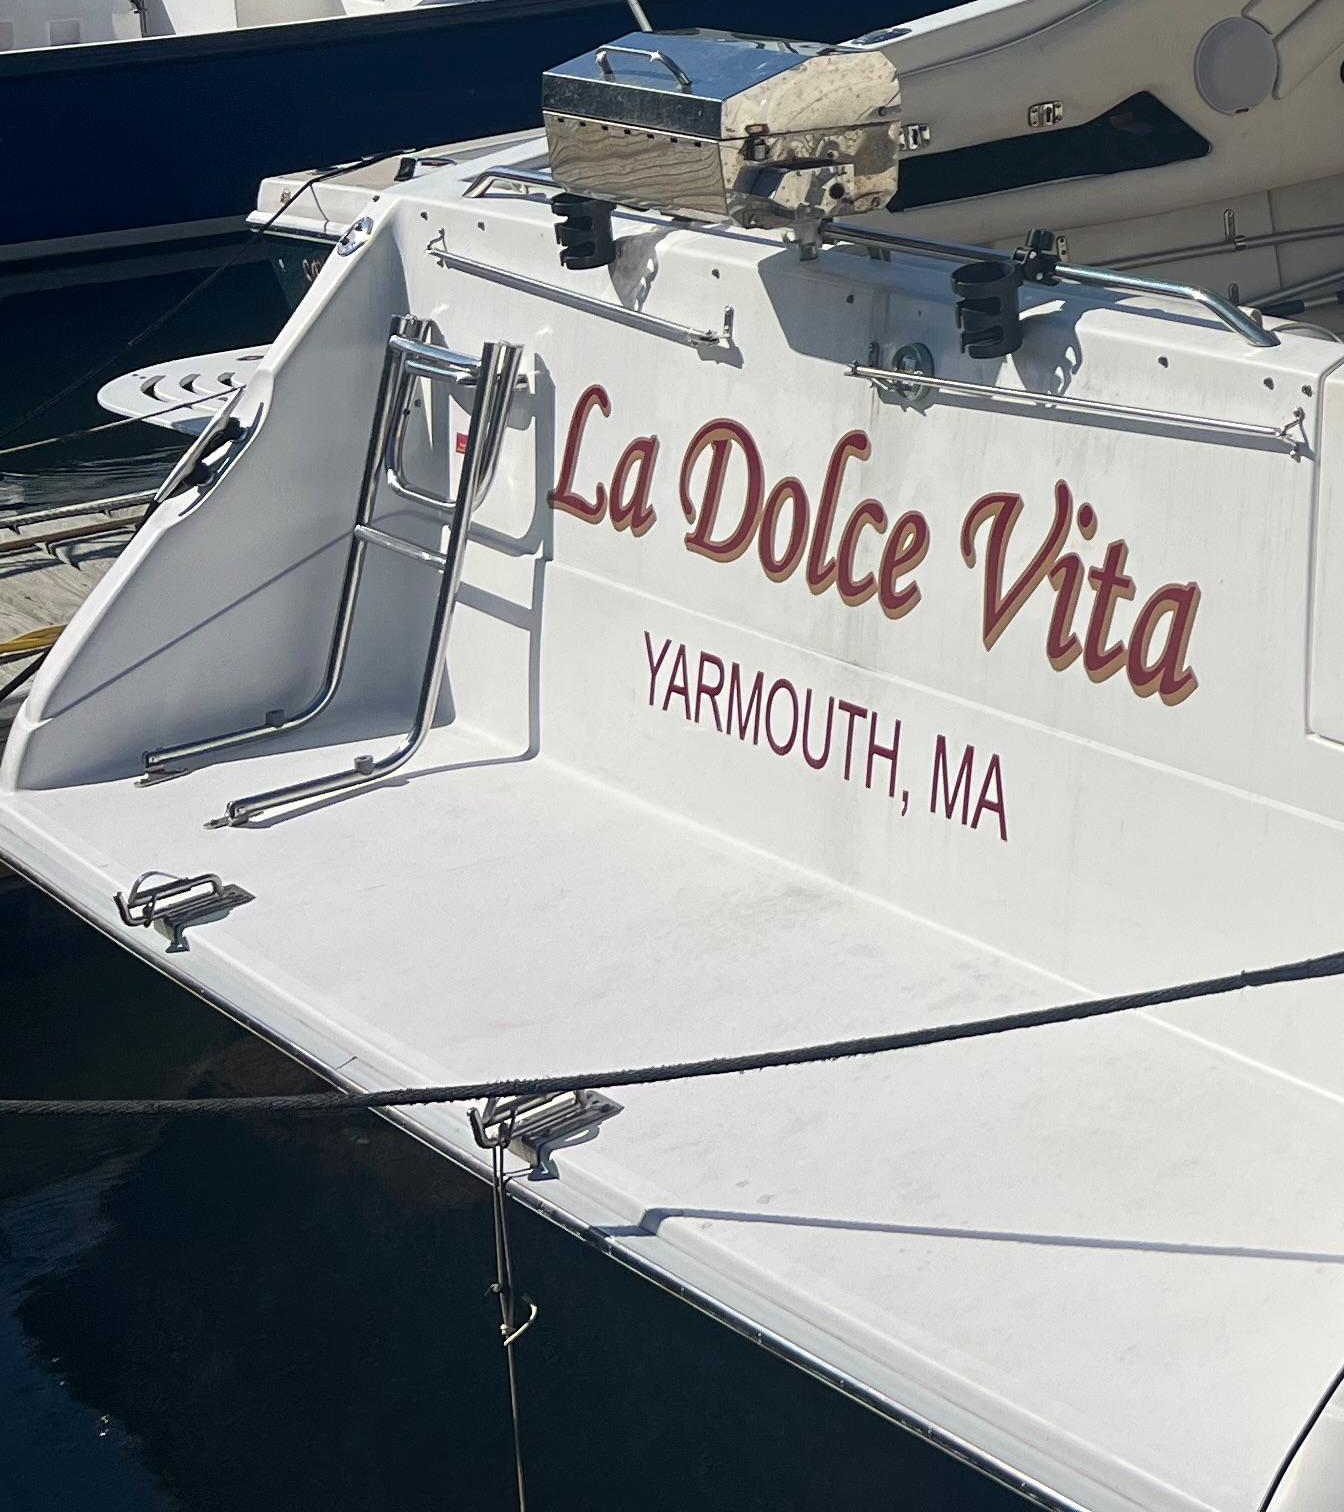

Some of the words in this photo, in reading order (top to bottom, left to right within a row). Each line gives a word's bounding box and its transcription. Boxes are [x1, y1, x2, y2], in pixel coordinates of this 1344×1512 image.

[547, 384, 660, 537] La
[679, 417, 931, 620] Dolce
[961, 479, 1202, 706] Vita
[644, 630, 908, 816] YARMOUTH,
[930, 734, 1008, 842] MA
